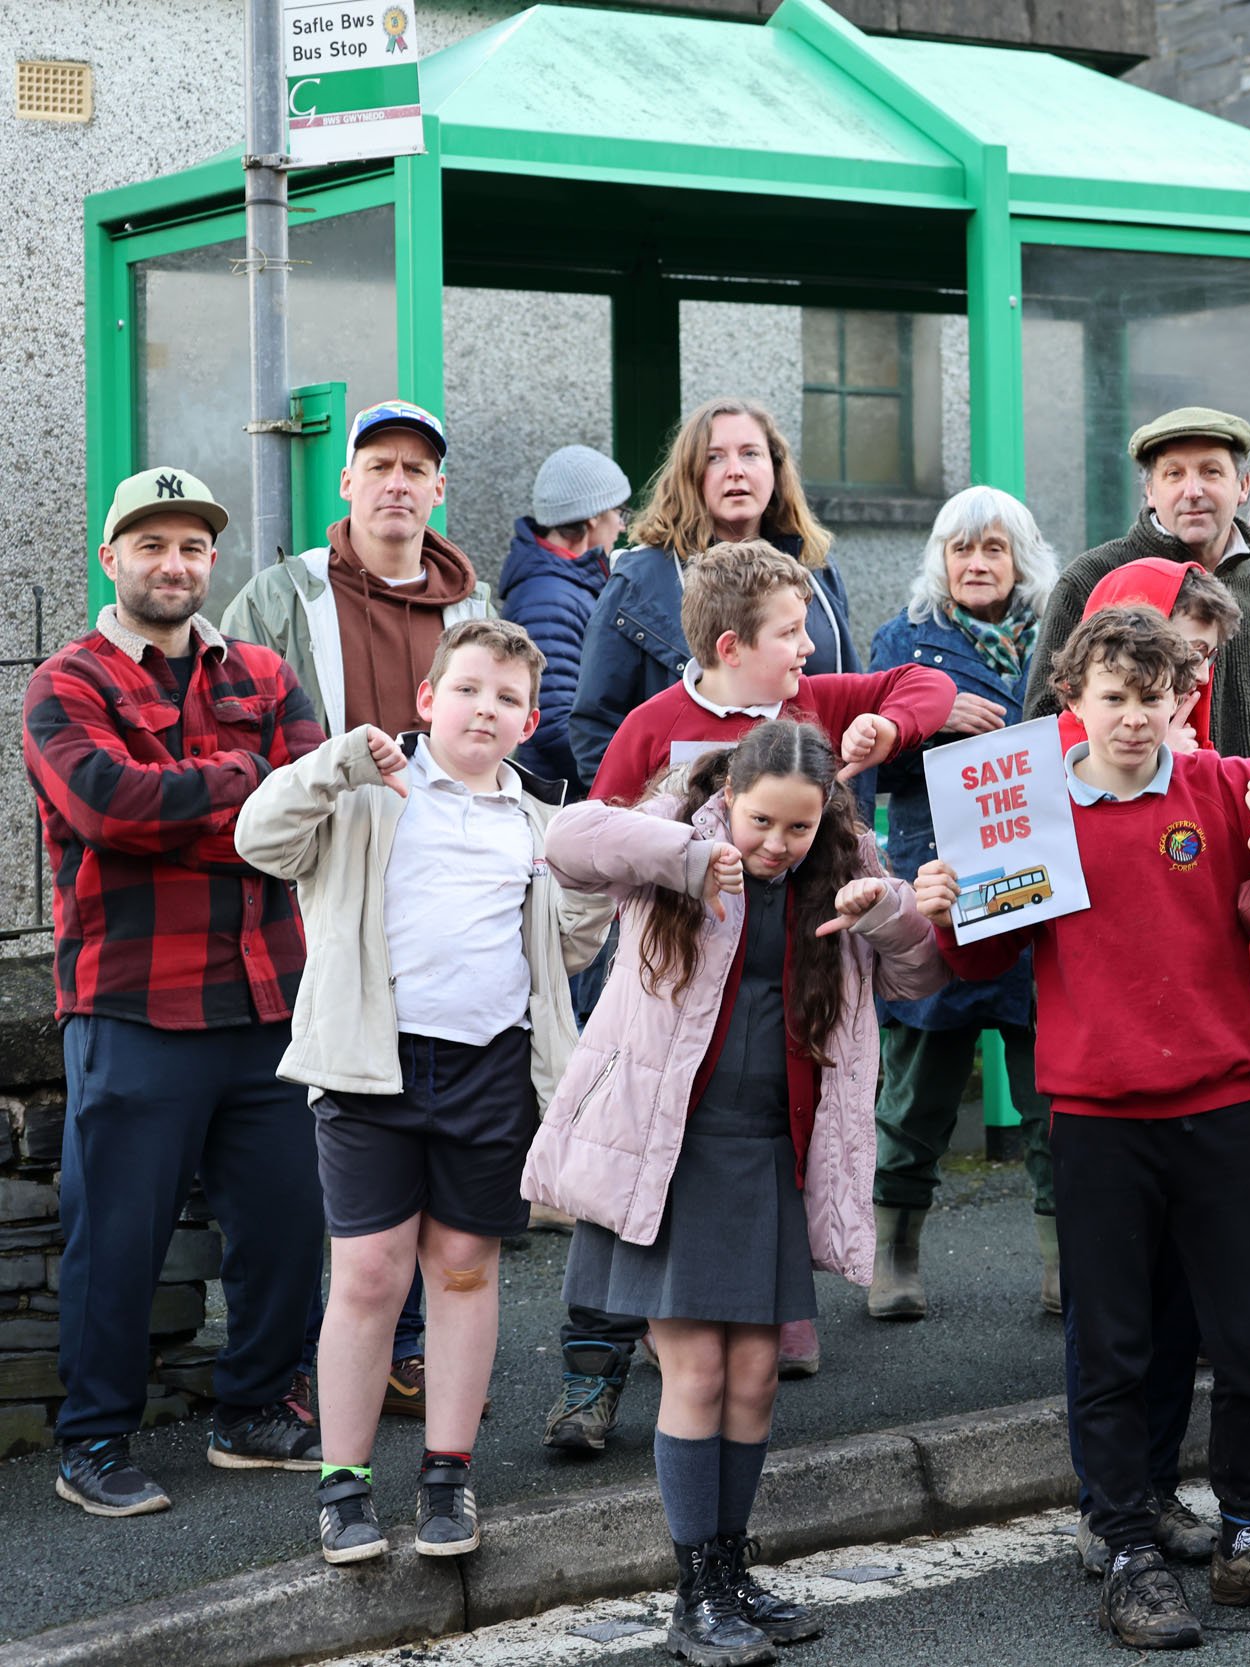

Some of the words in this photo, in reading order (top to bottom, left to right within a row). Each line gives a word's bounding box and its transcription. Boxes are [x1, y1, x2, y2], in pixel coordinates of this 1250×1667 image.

[292, 17, 334, 35] Safle
[341, 14, 374, 30] Bws
[292, 45, 322, 61] Bus
[330, 41, 368, 57] Stop
[322, 117, 341, 126] BWS
[343, 111, 385, 123] GWYNEDD
[961, 750, 1032, 790] SAVE
[975, 785, 1028, 818] THE
[979, 816, 1032, 849] BUS
